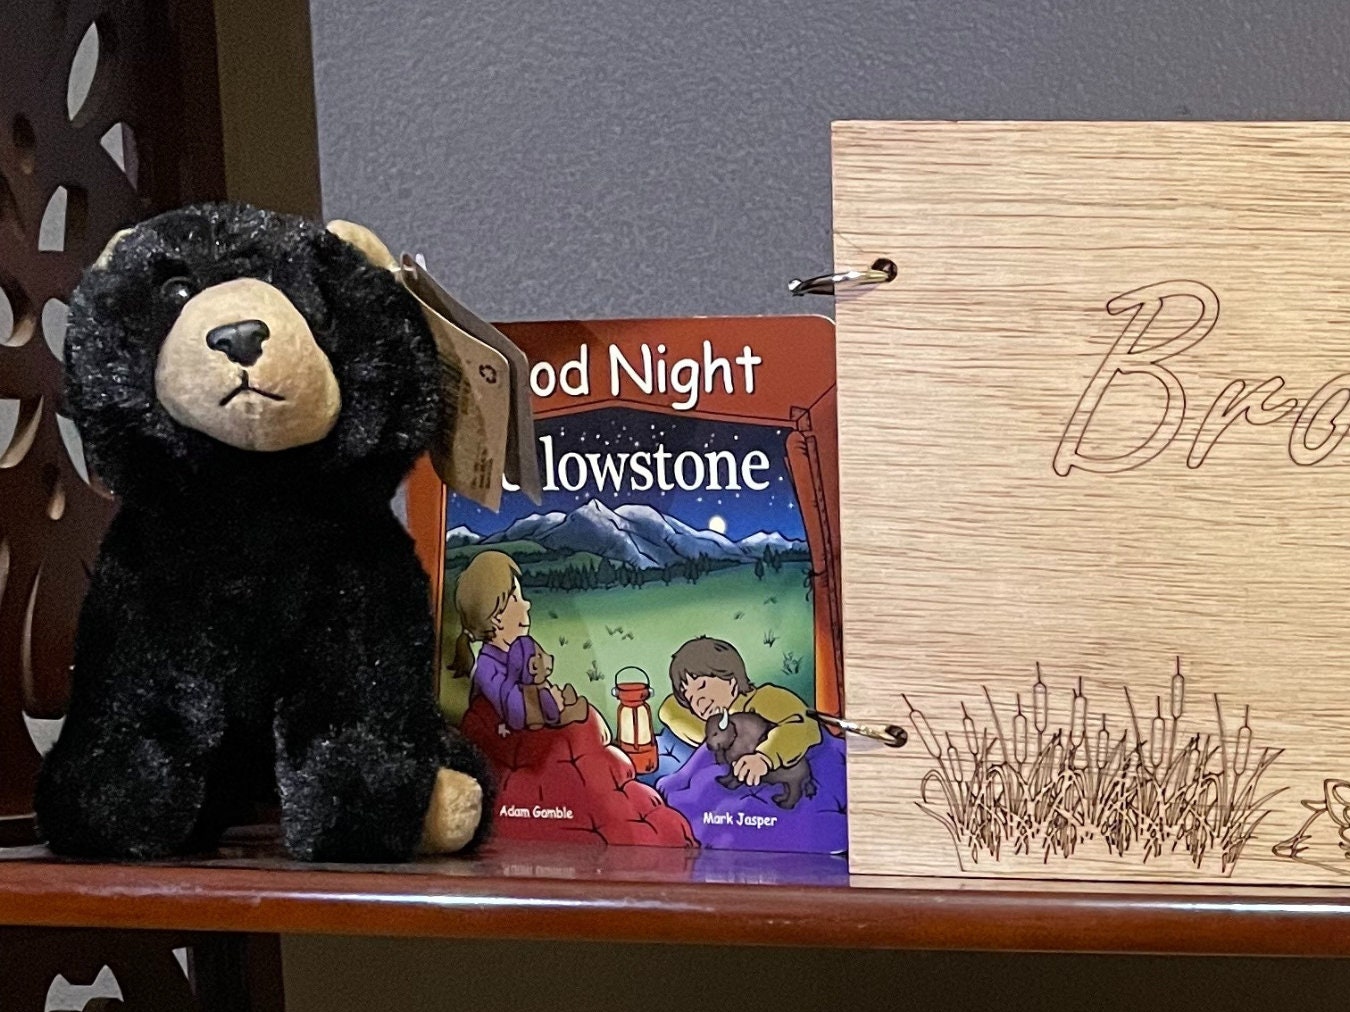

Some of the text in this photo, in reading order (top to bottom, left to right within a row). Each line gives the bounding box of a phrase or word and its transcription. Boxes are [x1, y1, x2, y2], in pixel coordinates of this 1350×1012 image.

[529, 343, 589, 397] od
[608, 340, 762, 411] Night
[502, 435, 770, 491] lowstone
[500, 805, 574, 819] Adam Gamble
[703, 812, 778, 829] Mark Jasper
